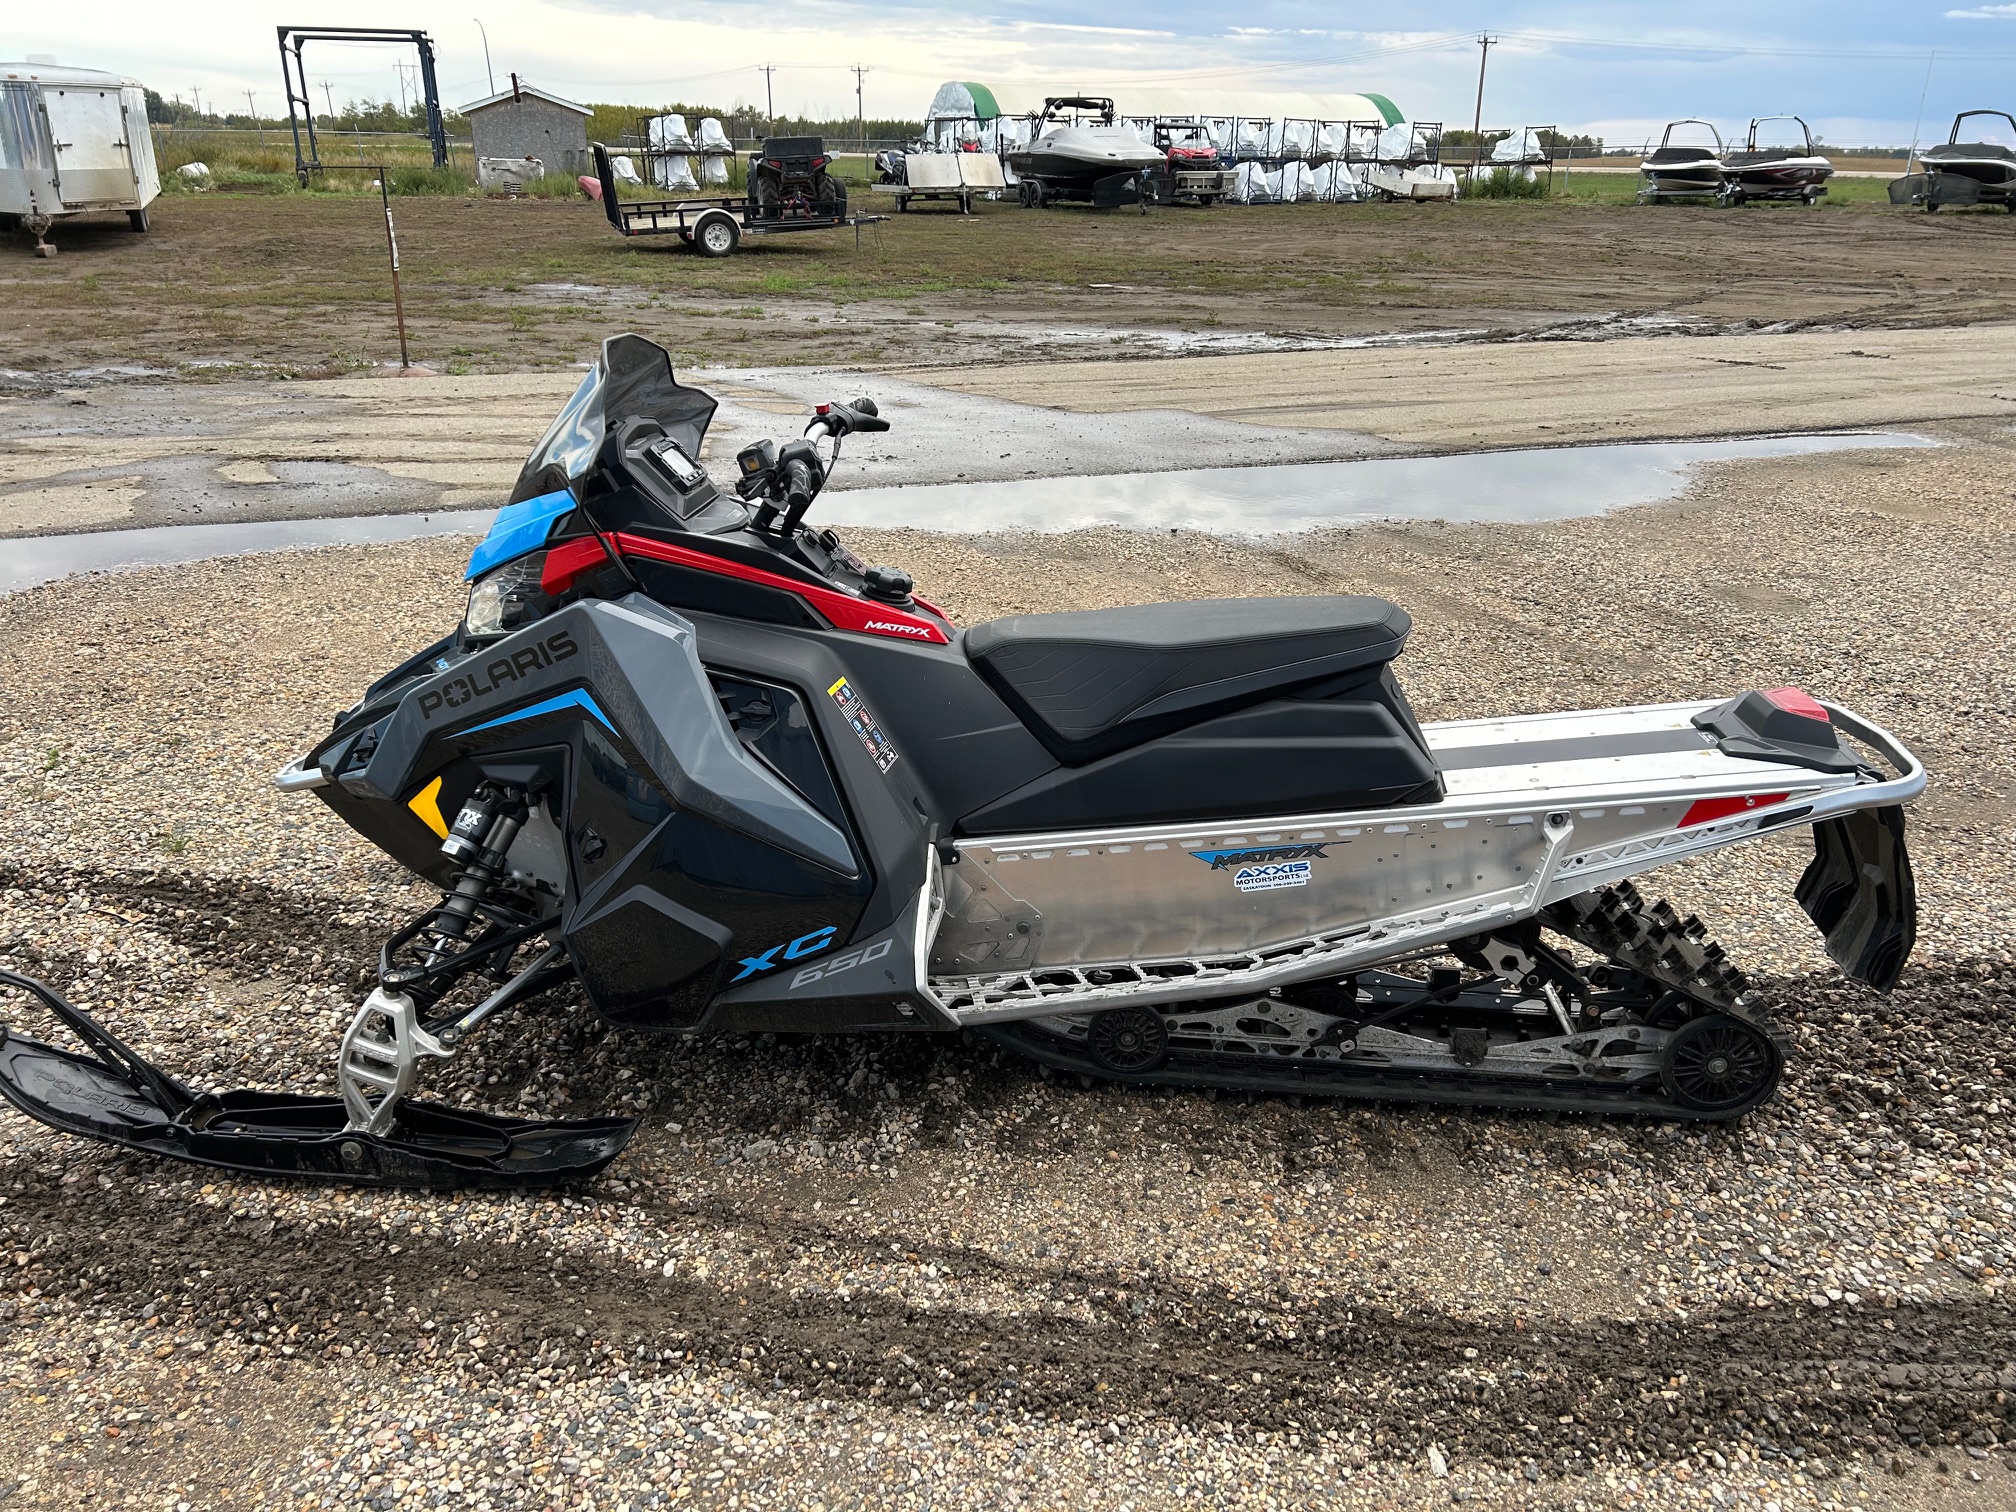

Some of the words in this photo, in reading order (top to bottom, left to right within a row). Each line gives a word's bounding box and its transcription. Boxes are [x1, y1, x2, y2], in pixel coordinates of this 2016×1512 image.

[864, 620, 931, 639] MATRYX
[417, 630, 579, 720] POLARIS
[1211, 843, 1330, 870] MATRYX
[1236, 862, 1310, 879] AXXIS
[1235, 873, 1301, 886] MOTORSPORTS
[729, 925, 838, 983] XC
[789, 938, 893, 990] 650
[33, 1068, 149, 1116] POLARIS
